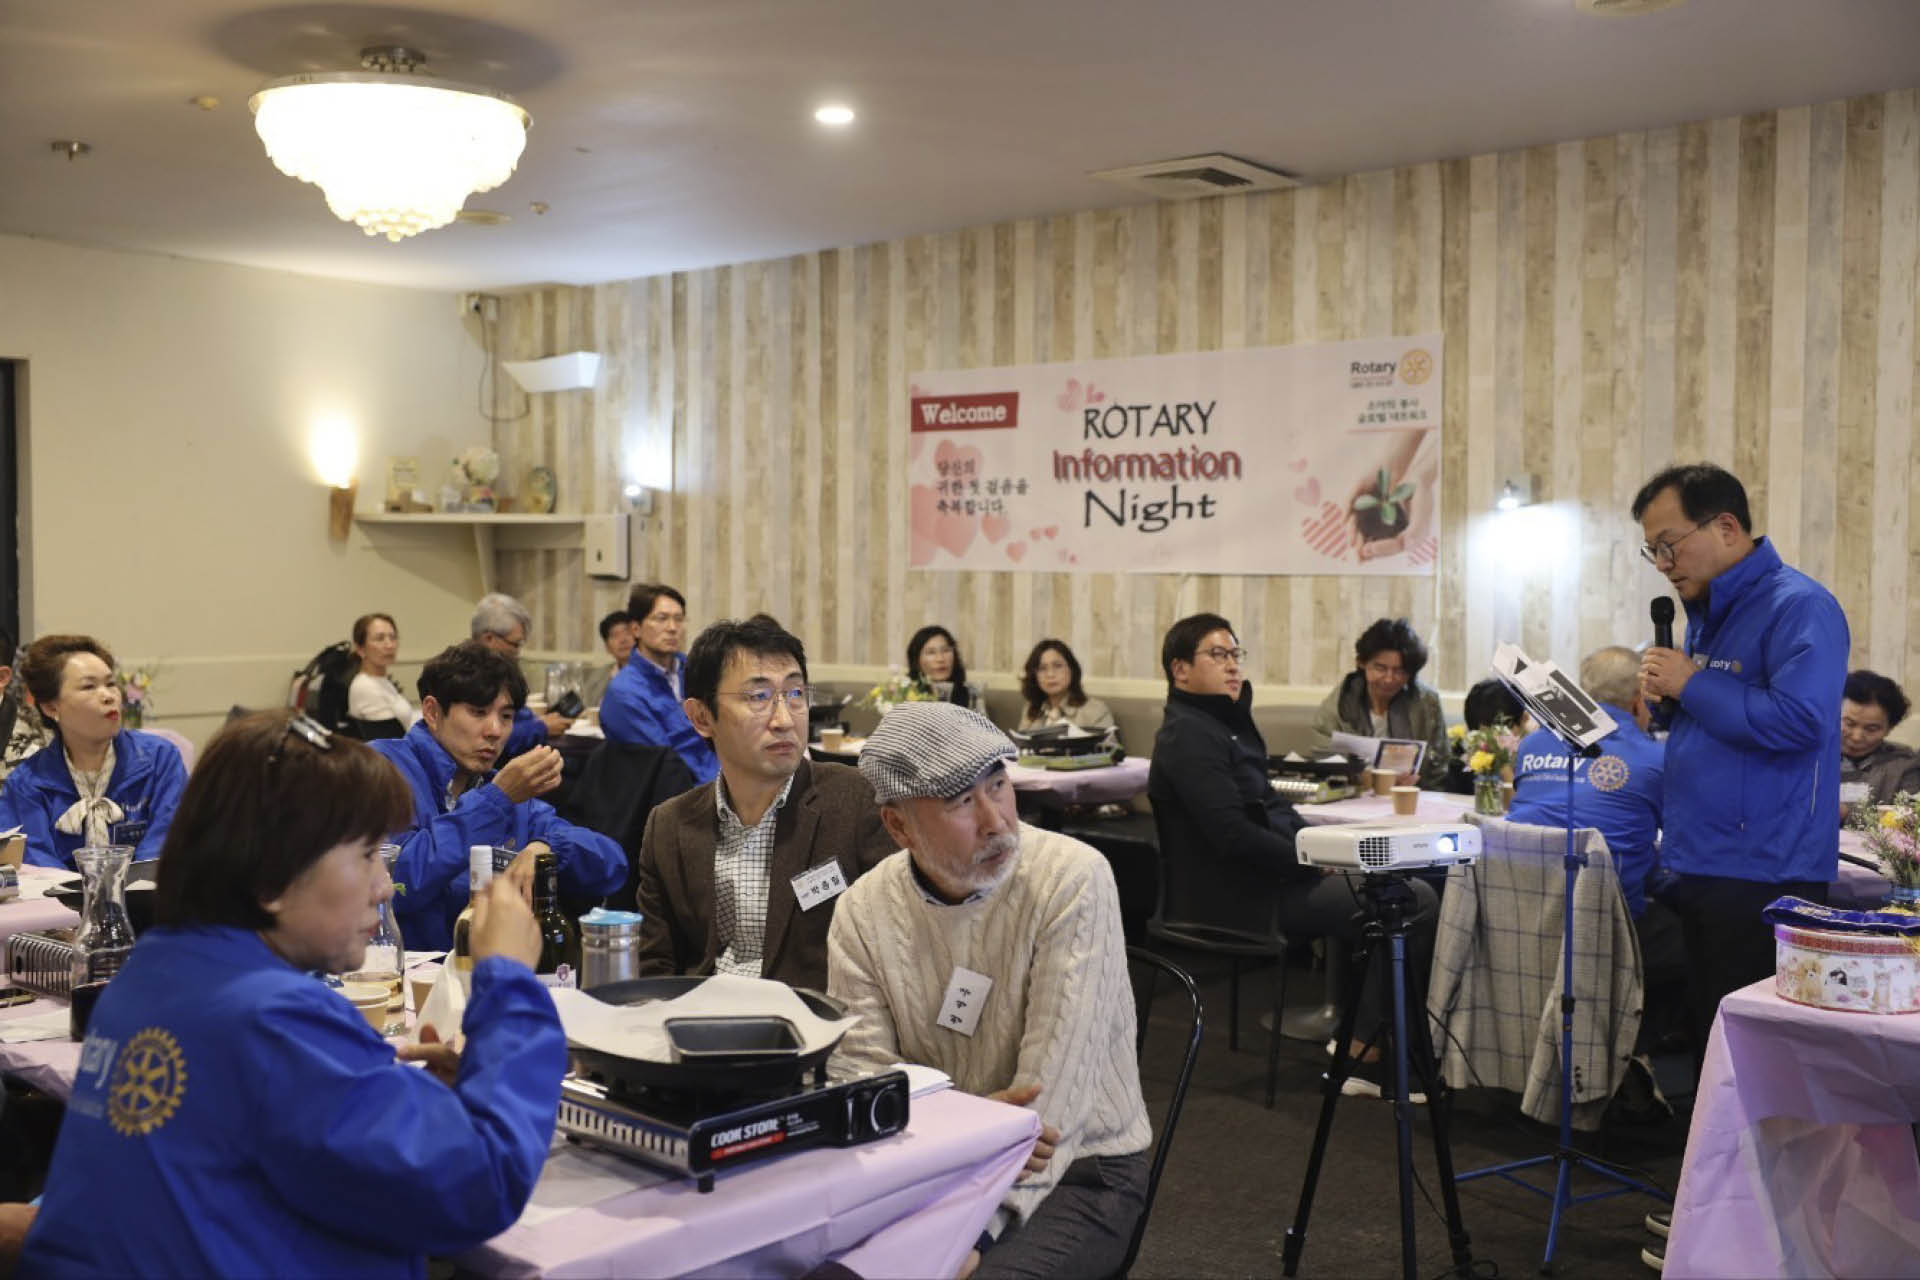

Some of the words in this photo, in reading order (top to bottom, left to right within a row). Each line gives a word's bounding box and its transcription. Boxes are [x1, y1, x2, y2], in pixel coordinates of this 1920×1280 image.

[1350, 361, 1397, 375] Rotary
[920, 402, 1008, 425] Welcome
[1083, 400, 1217, 440] ROTARY
[1053, 444, 1242, 483] Information
[1083, 484, 1217, 533] Night
[1521, 753, 1587, 773] Rotary
[710, 1127, 742, 1149] COOK
